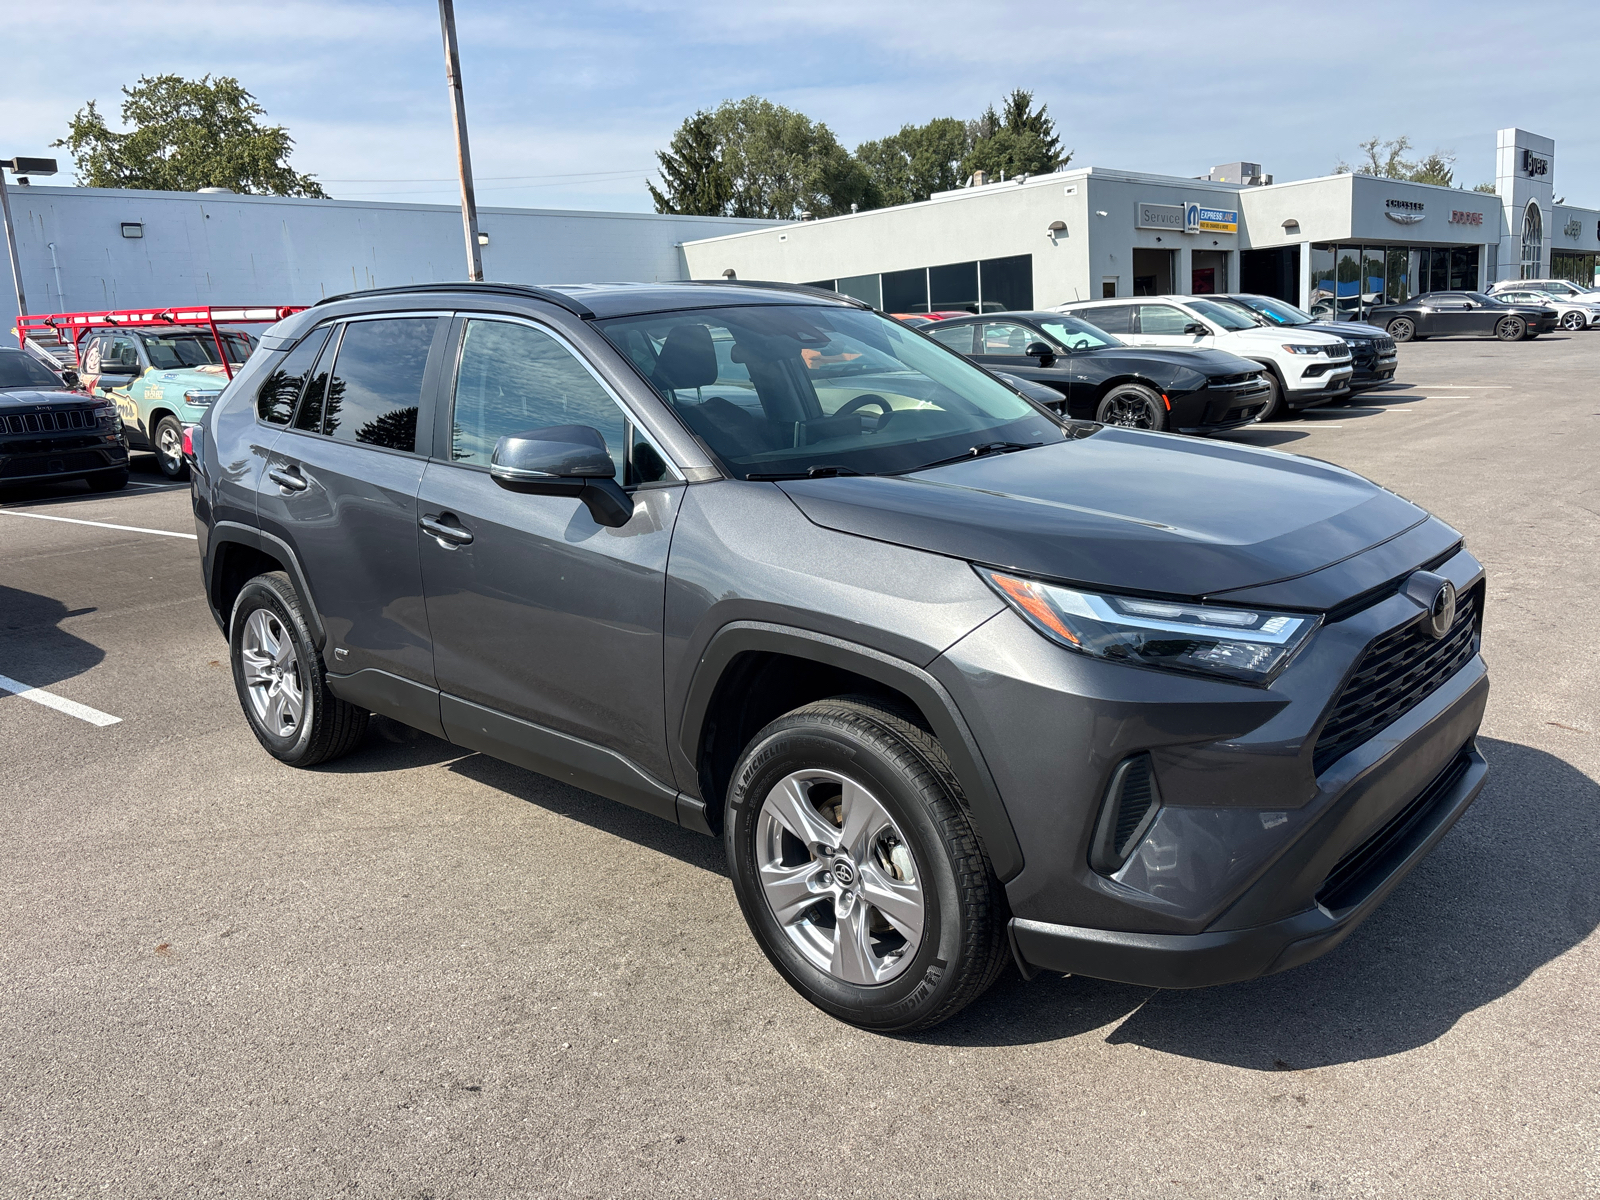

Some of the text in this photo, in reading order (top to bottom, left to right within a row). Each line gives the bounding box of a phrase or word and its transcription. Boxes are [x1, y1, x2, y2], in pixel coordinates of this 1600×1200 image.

[1523, 149, 1549, 177] Byers
[1144, 209, 1180, 225] Service
[742, 740, 790, 785] MICHELIN
